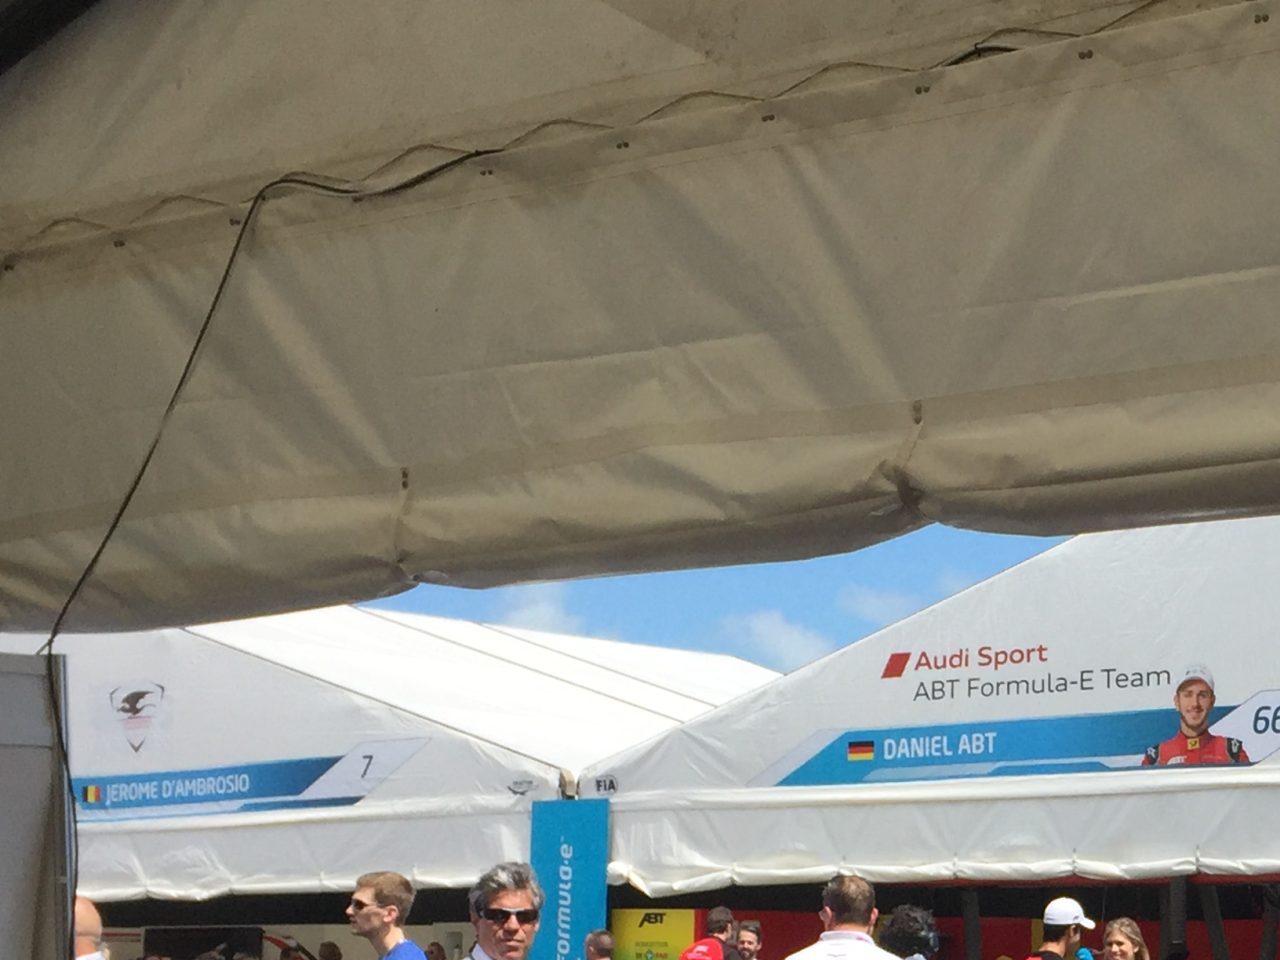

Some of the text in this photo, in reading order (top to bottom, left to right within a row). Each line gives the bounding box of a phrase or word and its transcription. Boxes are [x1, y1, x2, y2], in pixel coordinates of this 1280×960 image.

[914, 643, 1049, 671] Audi Sport
[913, 667, 1171, 702] ABT Formula-E Team
[882, 731, 998, 761] DANIEL ABT
[361, 754, 374, 779] 7
[105, 773, 250, 806] JEROME D'AMBROSIO
[638, 912, 666, 928] ABT
